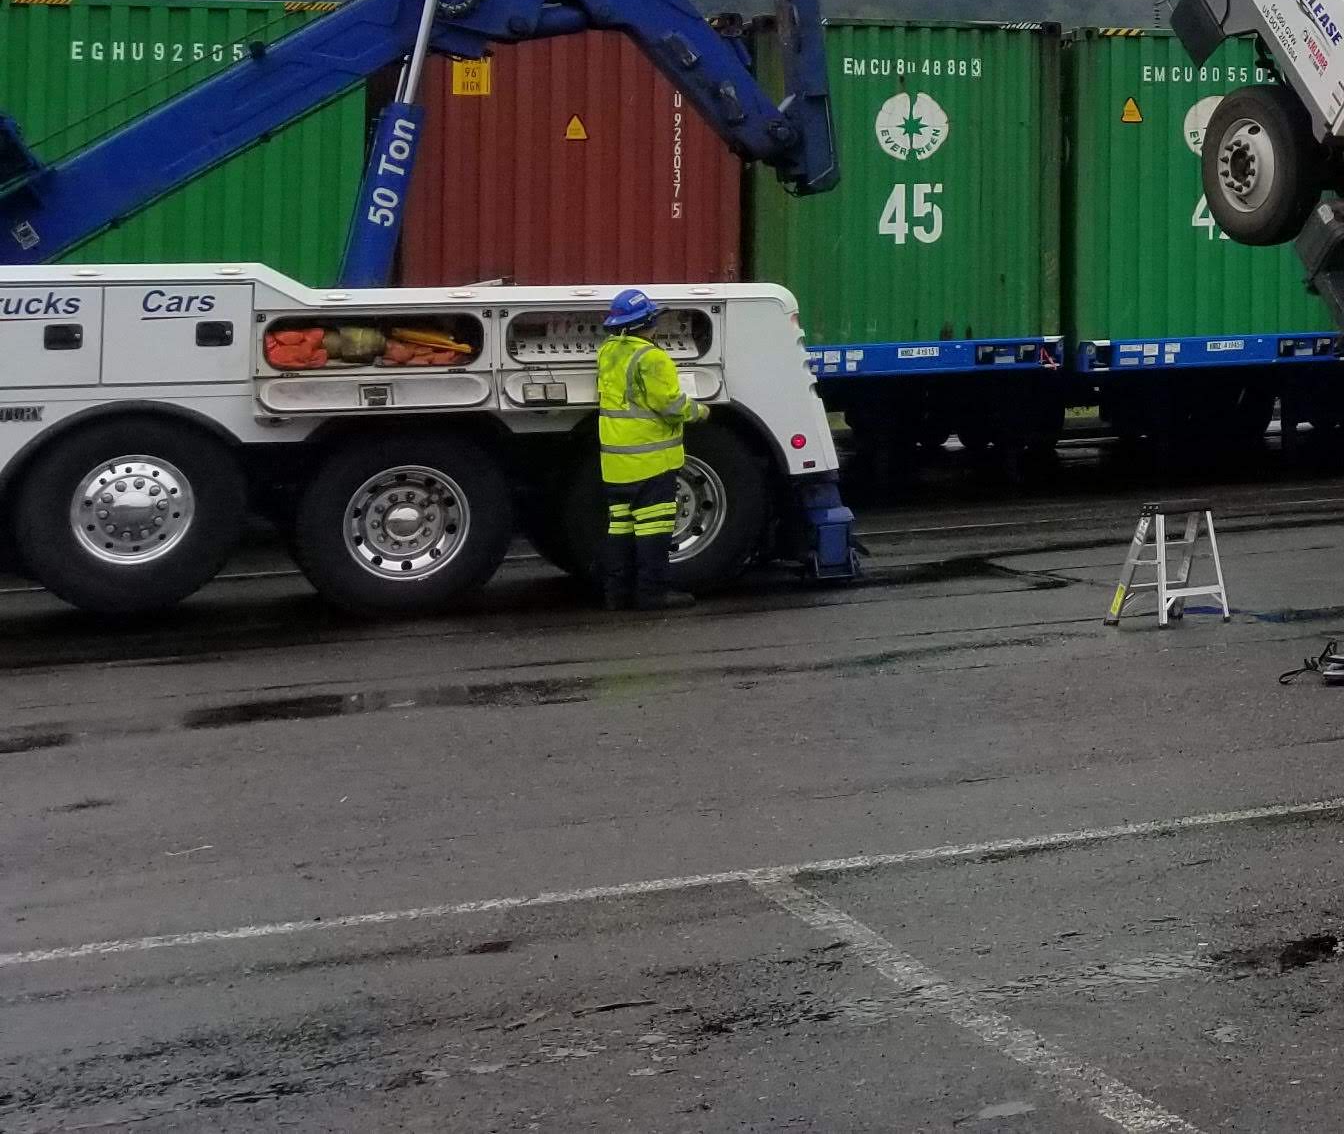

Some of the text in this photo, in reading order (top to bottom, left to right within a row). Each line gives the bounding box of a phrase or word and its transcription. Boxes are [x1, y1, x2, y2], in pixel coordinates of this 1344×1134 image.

[367, 117, 417, 227] 50 Ton
[877, 182, 944, 244] 45
[1191, 194, 1231, 241] 4
[142, 289, 216, 313] Cars
